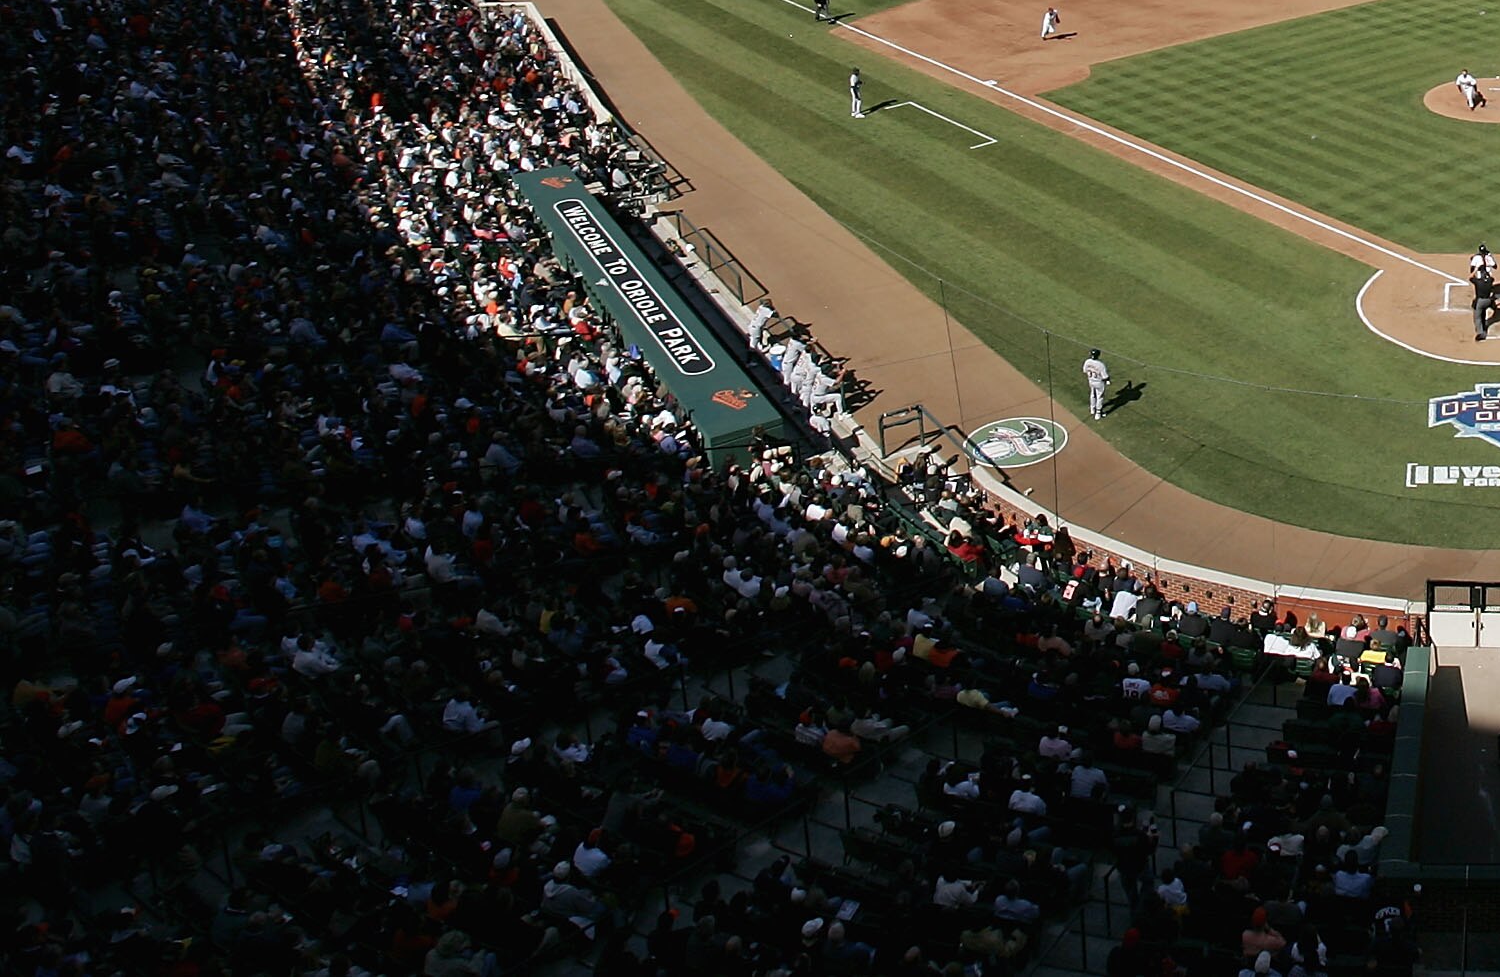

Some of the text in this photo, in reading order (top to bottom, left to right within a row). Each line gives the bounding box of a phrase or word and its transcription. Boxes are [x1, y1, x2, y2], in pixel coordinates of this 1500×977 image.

[562, 205, 701, 366] WELCOME TO ORIOLE PARK
